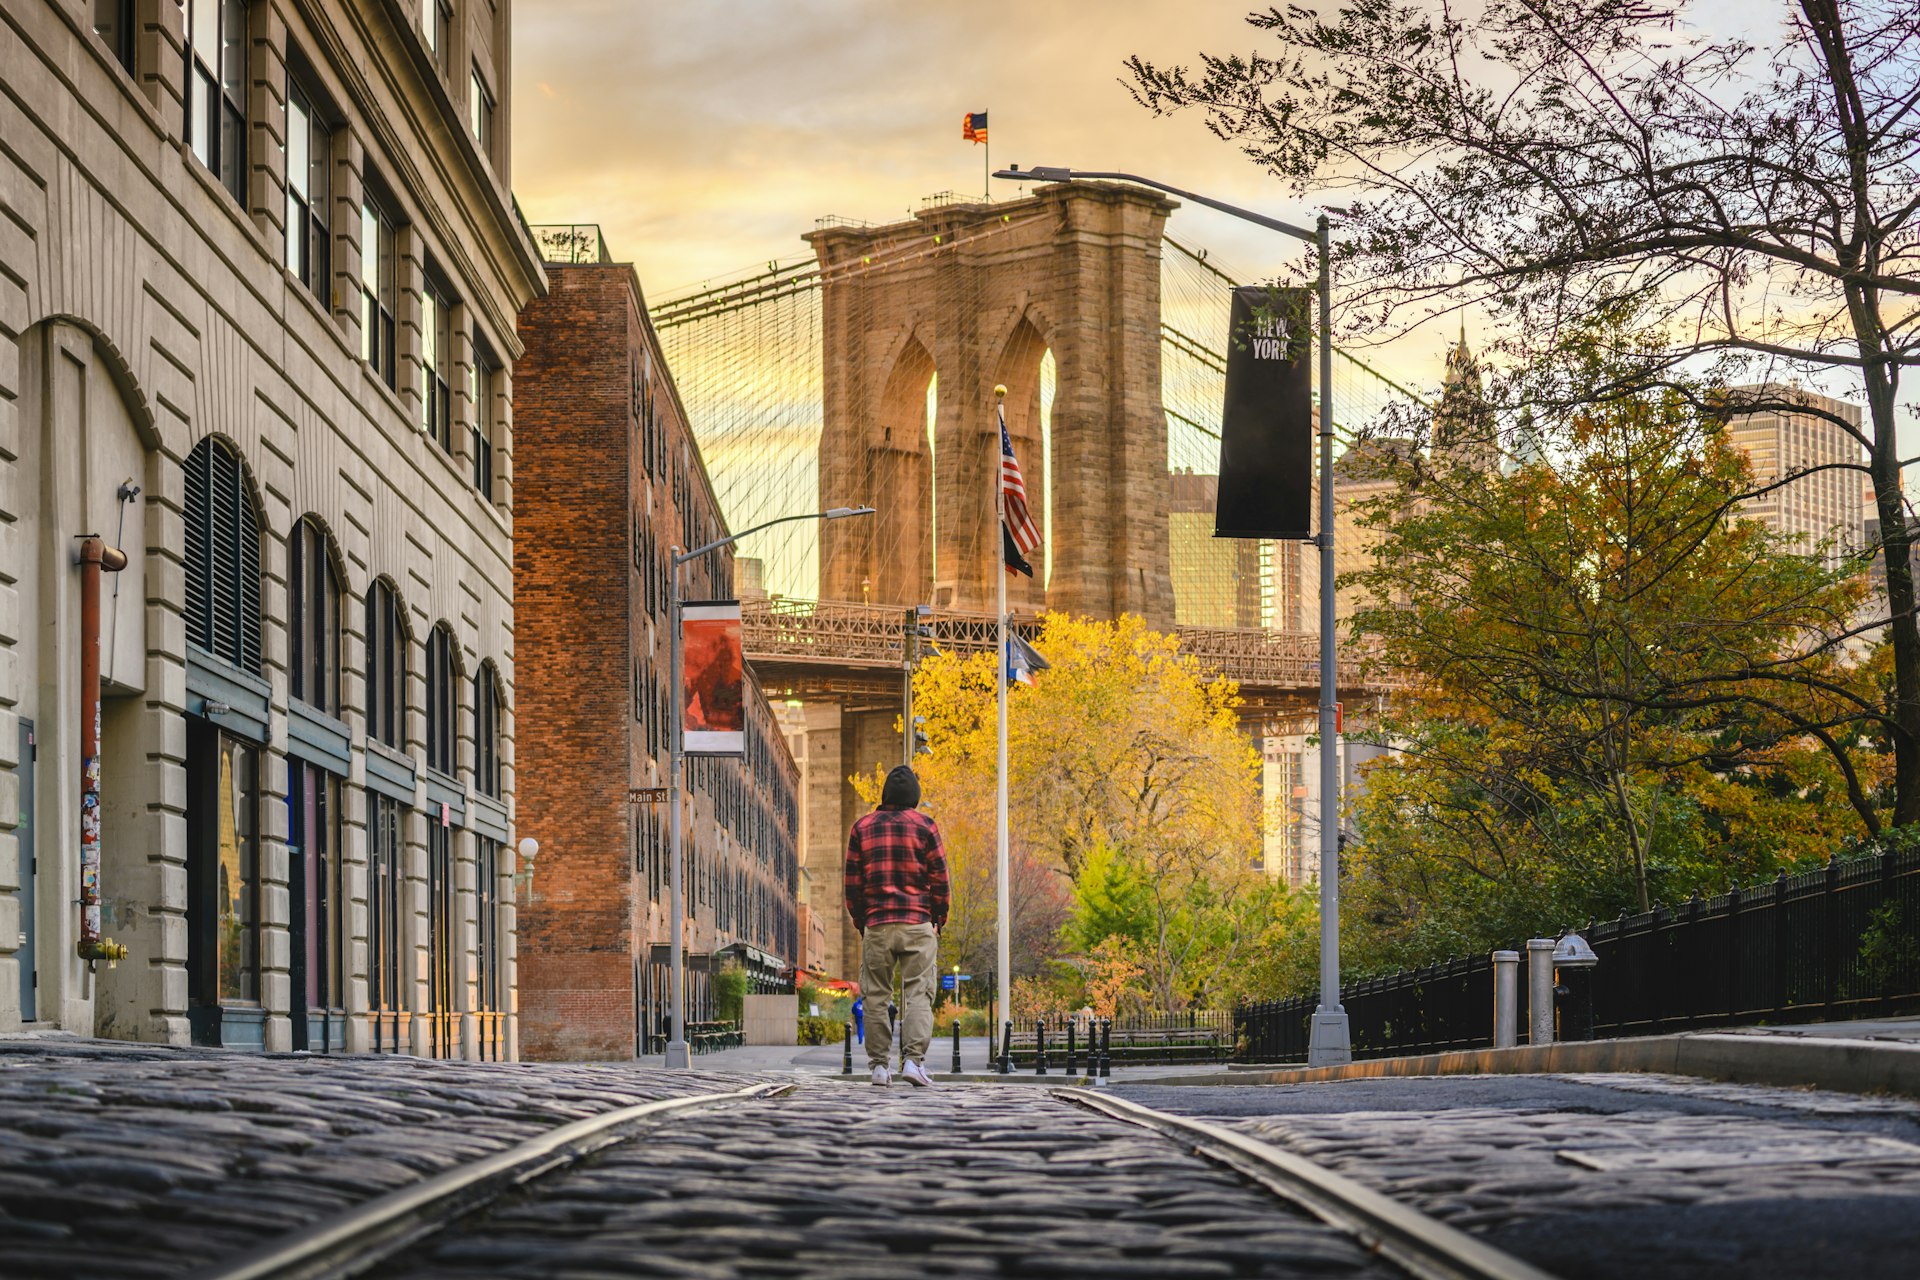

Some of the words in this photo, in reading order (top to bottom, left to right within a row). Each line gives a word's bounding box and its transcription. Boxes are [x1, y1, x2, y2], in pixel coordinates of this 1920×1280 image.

[1257, 317, 1288, 337] NEW
[1252, 339, 1288, 360] YORK
[630, 792, 652, 802] Main
[656, 792, 666, 802] St
